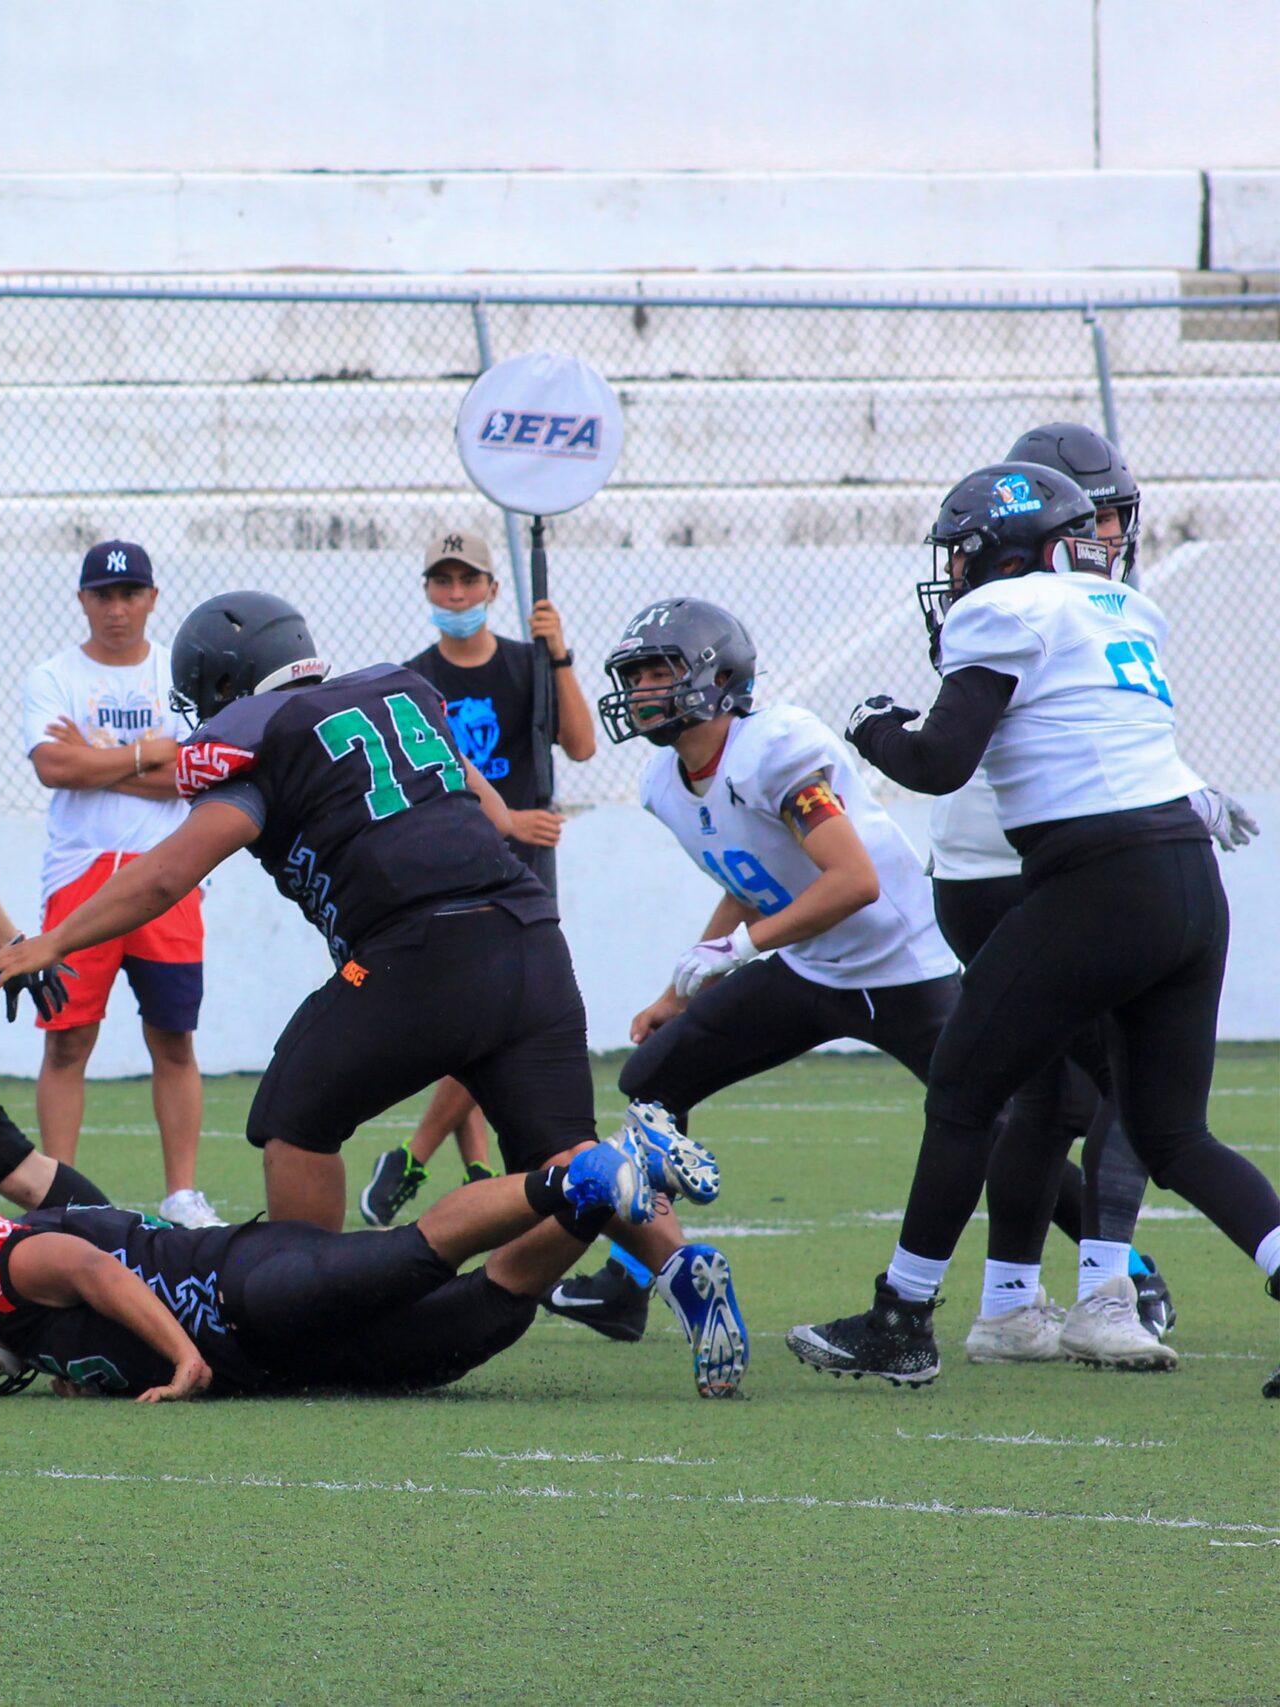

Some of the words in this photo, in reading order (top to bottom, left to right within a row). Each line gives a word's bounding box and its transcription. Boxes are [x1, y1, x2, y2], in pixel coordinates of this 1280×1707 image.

[107, 550, 127, 572] NY
[98, 708, 152, 730] PUMA
[313, 692, 466, 821] 74
[702, 848, 795, 917] 19
